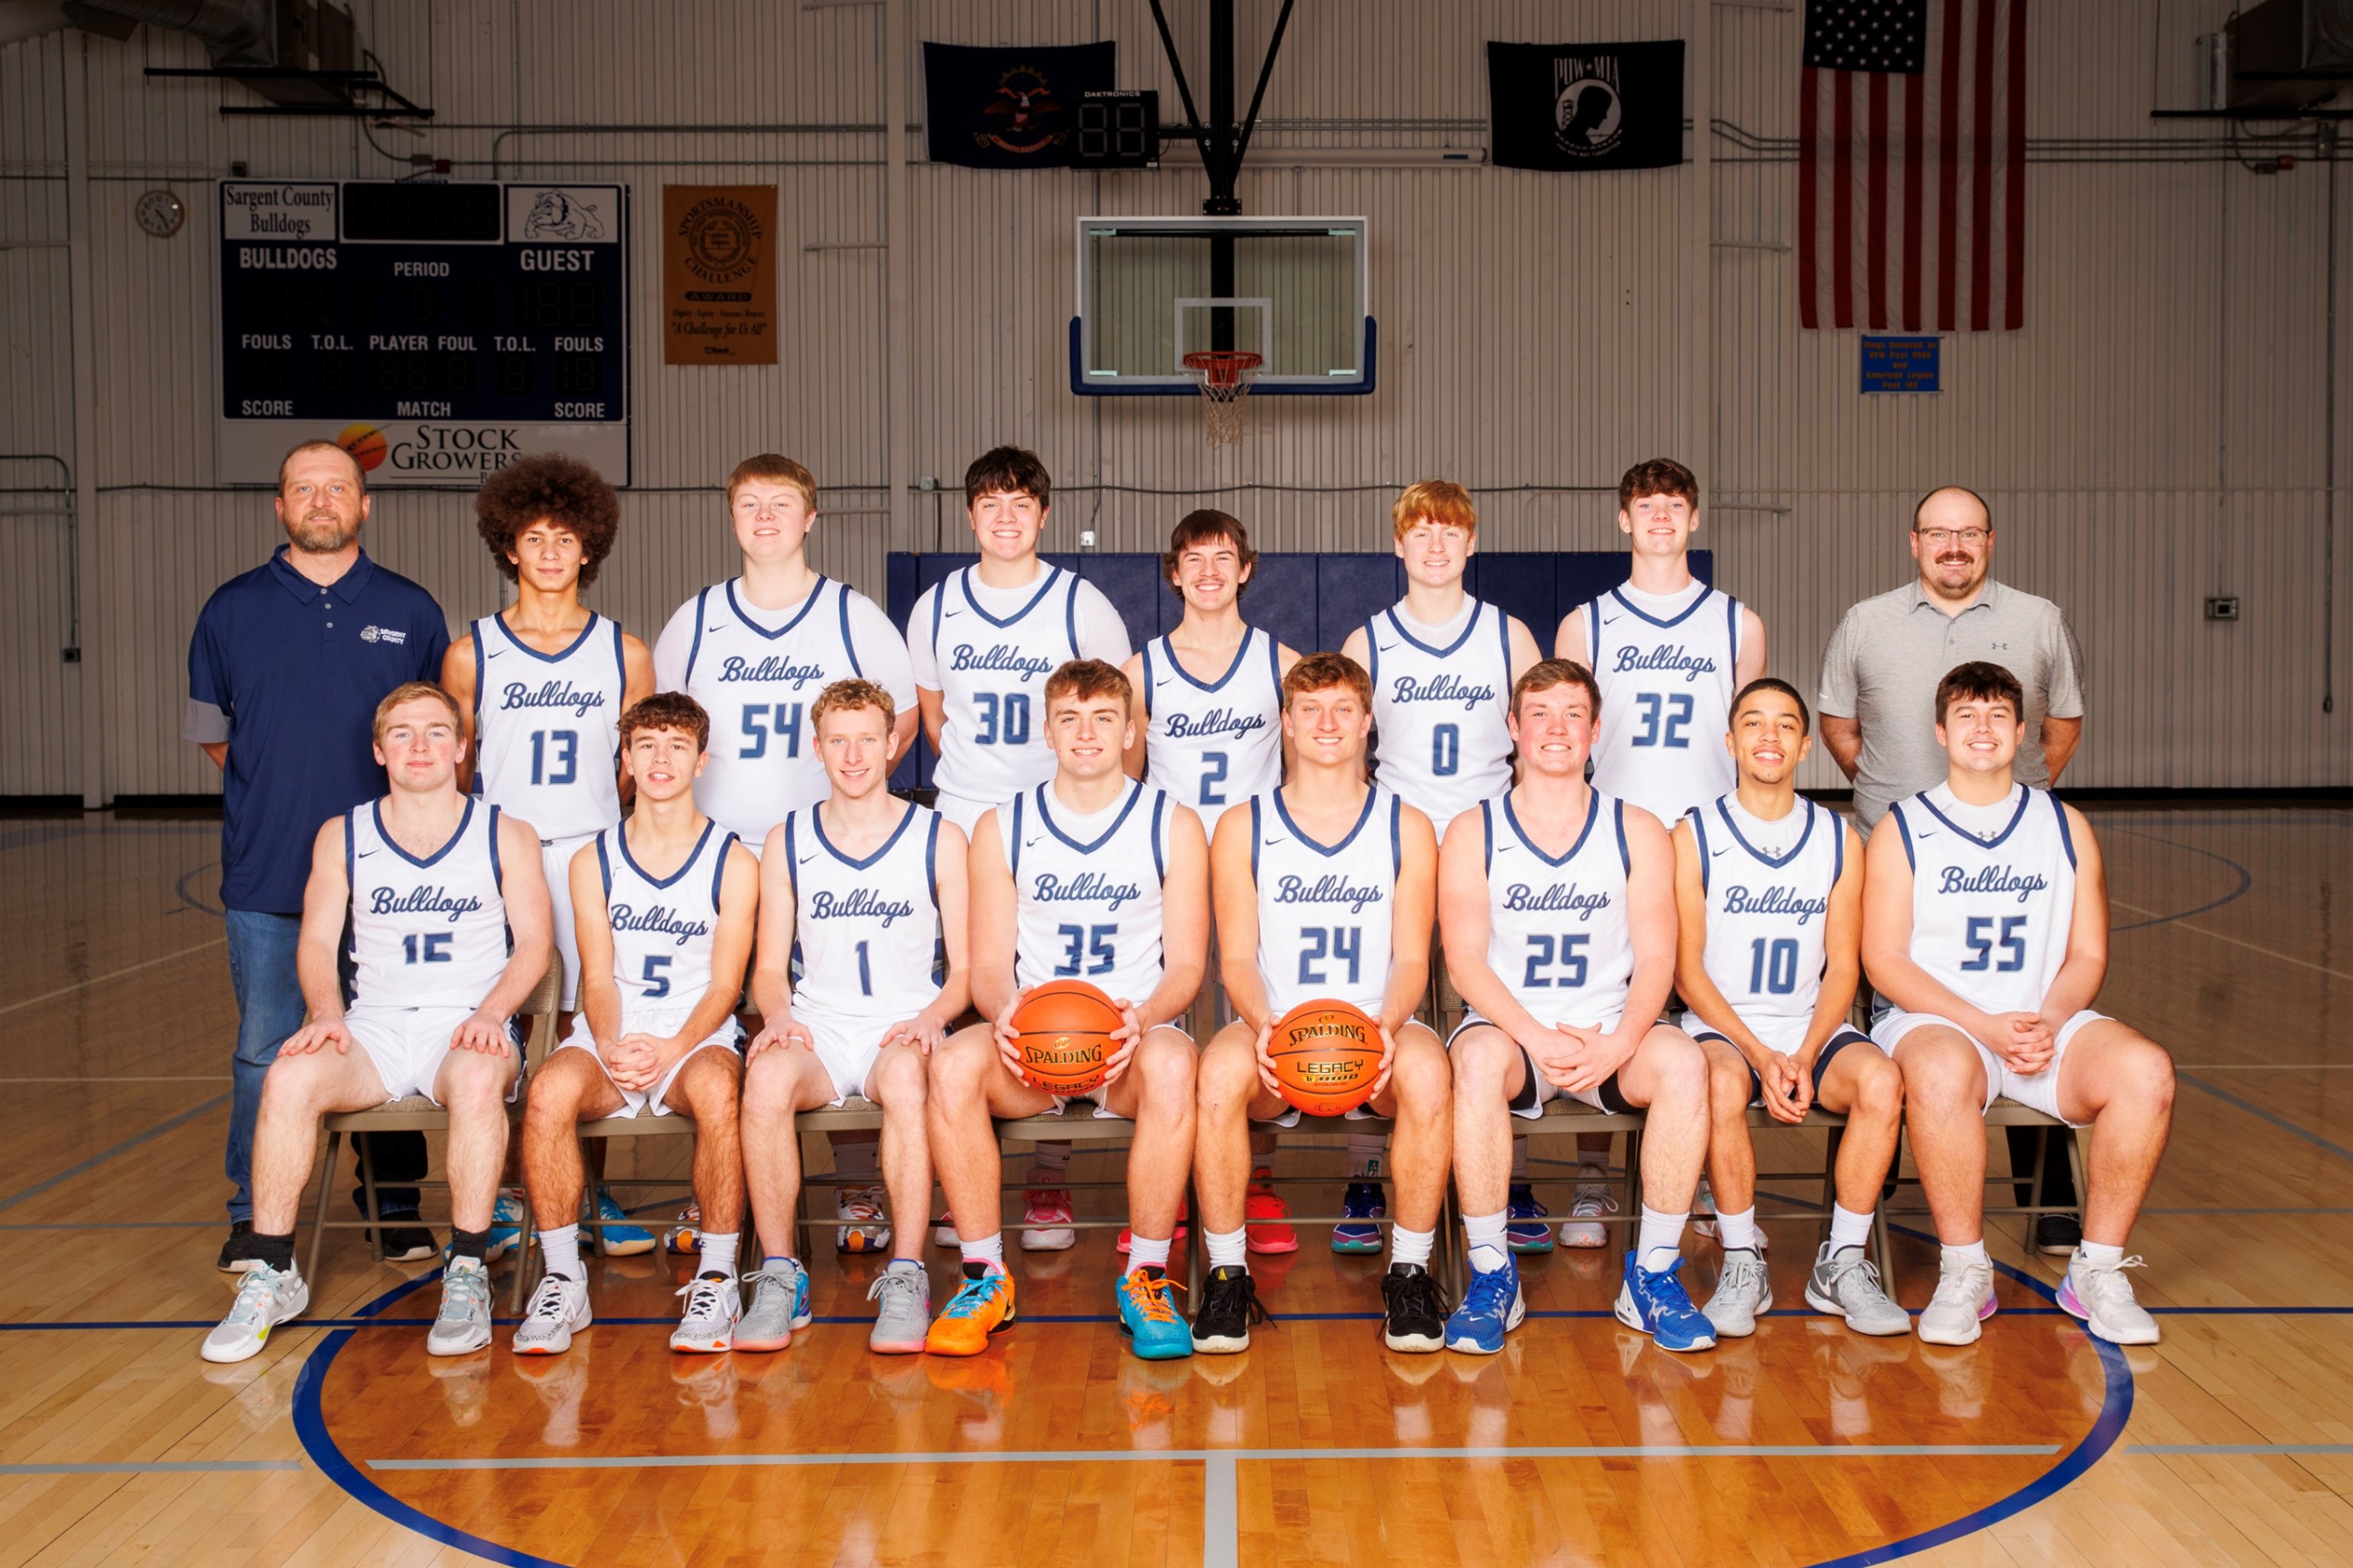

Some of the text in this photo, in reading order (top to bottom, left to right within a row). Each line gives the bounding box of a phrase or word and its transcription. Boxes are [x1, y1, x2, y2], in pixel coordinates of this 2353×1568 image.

[1553, 55, 1622, 102] POW MIA
[226, 186, 333, 213] Sargent County
[250, 212, 311, 239] Bulldogs
[679, 197, 762, 239] SPORTSMANSHIP
[239, 247, 337, 271] BULLDOGS
[393, 261, 450, 277] PERIOD
[520, 249, 595, 271] GUEST
[685, 257, 756, 283] CHALLENGE
[690, 293, 748, 301] AWARD
[242, 334, 292, 351] FOULS
[311, 335, 354, 351] T.O.L.
[370, 335, 477, 351] PLAYER FOUL
[493, 336, 536, 352] T.O.L.
[554, 336, 604, 352] FOULS
[683, 322, 724, 339] Challenge
[722, 322, 737, 338] for
[739, 322, 749, 335] Us
[242, 400, 294, 416] SCORE
[396, 402, 451, 417] MATCH
[554, 402, 605, 418] SCORE
[417, 425, 521, 450] STOCK
[380, 628, 406, 639] SARGENT
[382, 634, 405, 645] COUNTY
[717, 656, 824, 691] Bulldogs
[950, 643, 1053, 682] Bulldogs
[1613, 644, 1716, 682] Bulldogs
[500, 681, 605, 717] Bulldogs
[1392, 674, 1494, 711] Bulldogs
[739, 702, 804, 760] 54
[972, 691, 1031, 745] 30
[1164, 707, 1266, 740] Bulldogs
[1631, 692, 1694, 749] 32
[531, 729, 579, 786] 13
[1432, 722, 1459, 777] 0
[1199, 751, 1228, 806] 2
[1032, 872, 1141, 912] Bulldogs
[1273, 874, 1383, 914] Bulldogs
[1937, 864, 2048, 903] Bulldogs
[370, 885, 483, 922] Bulldogs
[811, 888, 913, 928] Bulldogs
[1503, 883, 1610, 922] Bulldogs
[1723, 885, 1828, 925] Bulldogs
[610, 903, 708, 945] Bulldogs
[1054, 922, 1119, 976] 35
[1298, 926, 1362, 986] 24
[1522, 932, 1591, 988] 25
[1960, 915, 2028, 972] 55
[640, 954, 673, 998] 5
[855, 939, 873, 997] 1
[1748, 937, 1799, 995] 10
[1026, 1044, 1103, 1063] SPALDING
[1288, 1024, 1367, 1047] SPALDING
[1032, 1075, 1100, 1090] LEGACY
[1297, 1059, 1363, 1073] LEGACY
